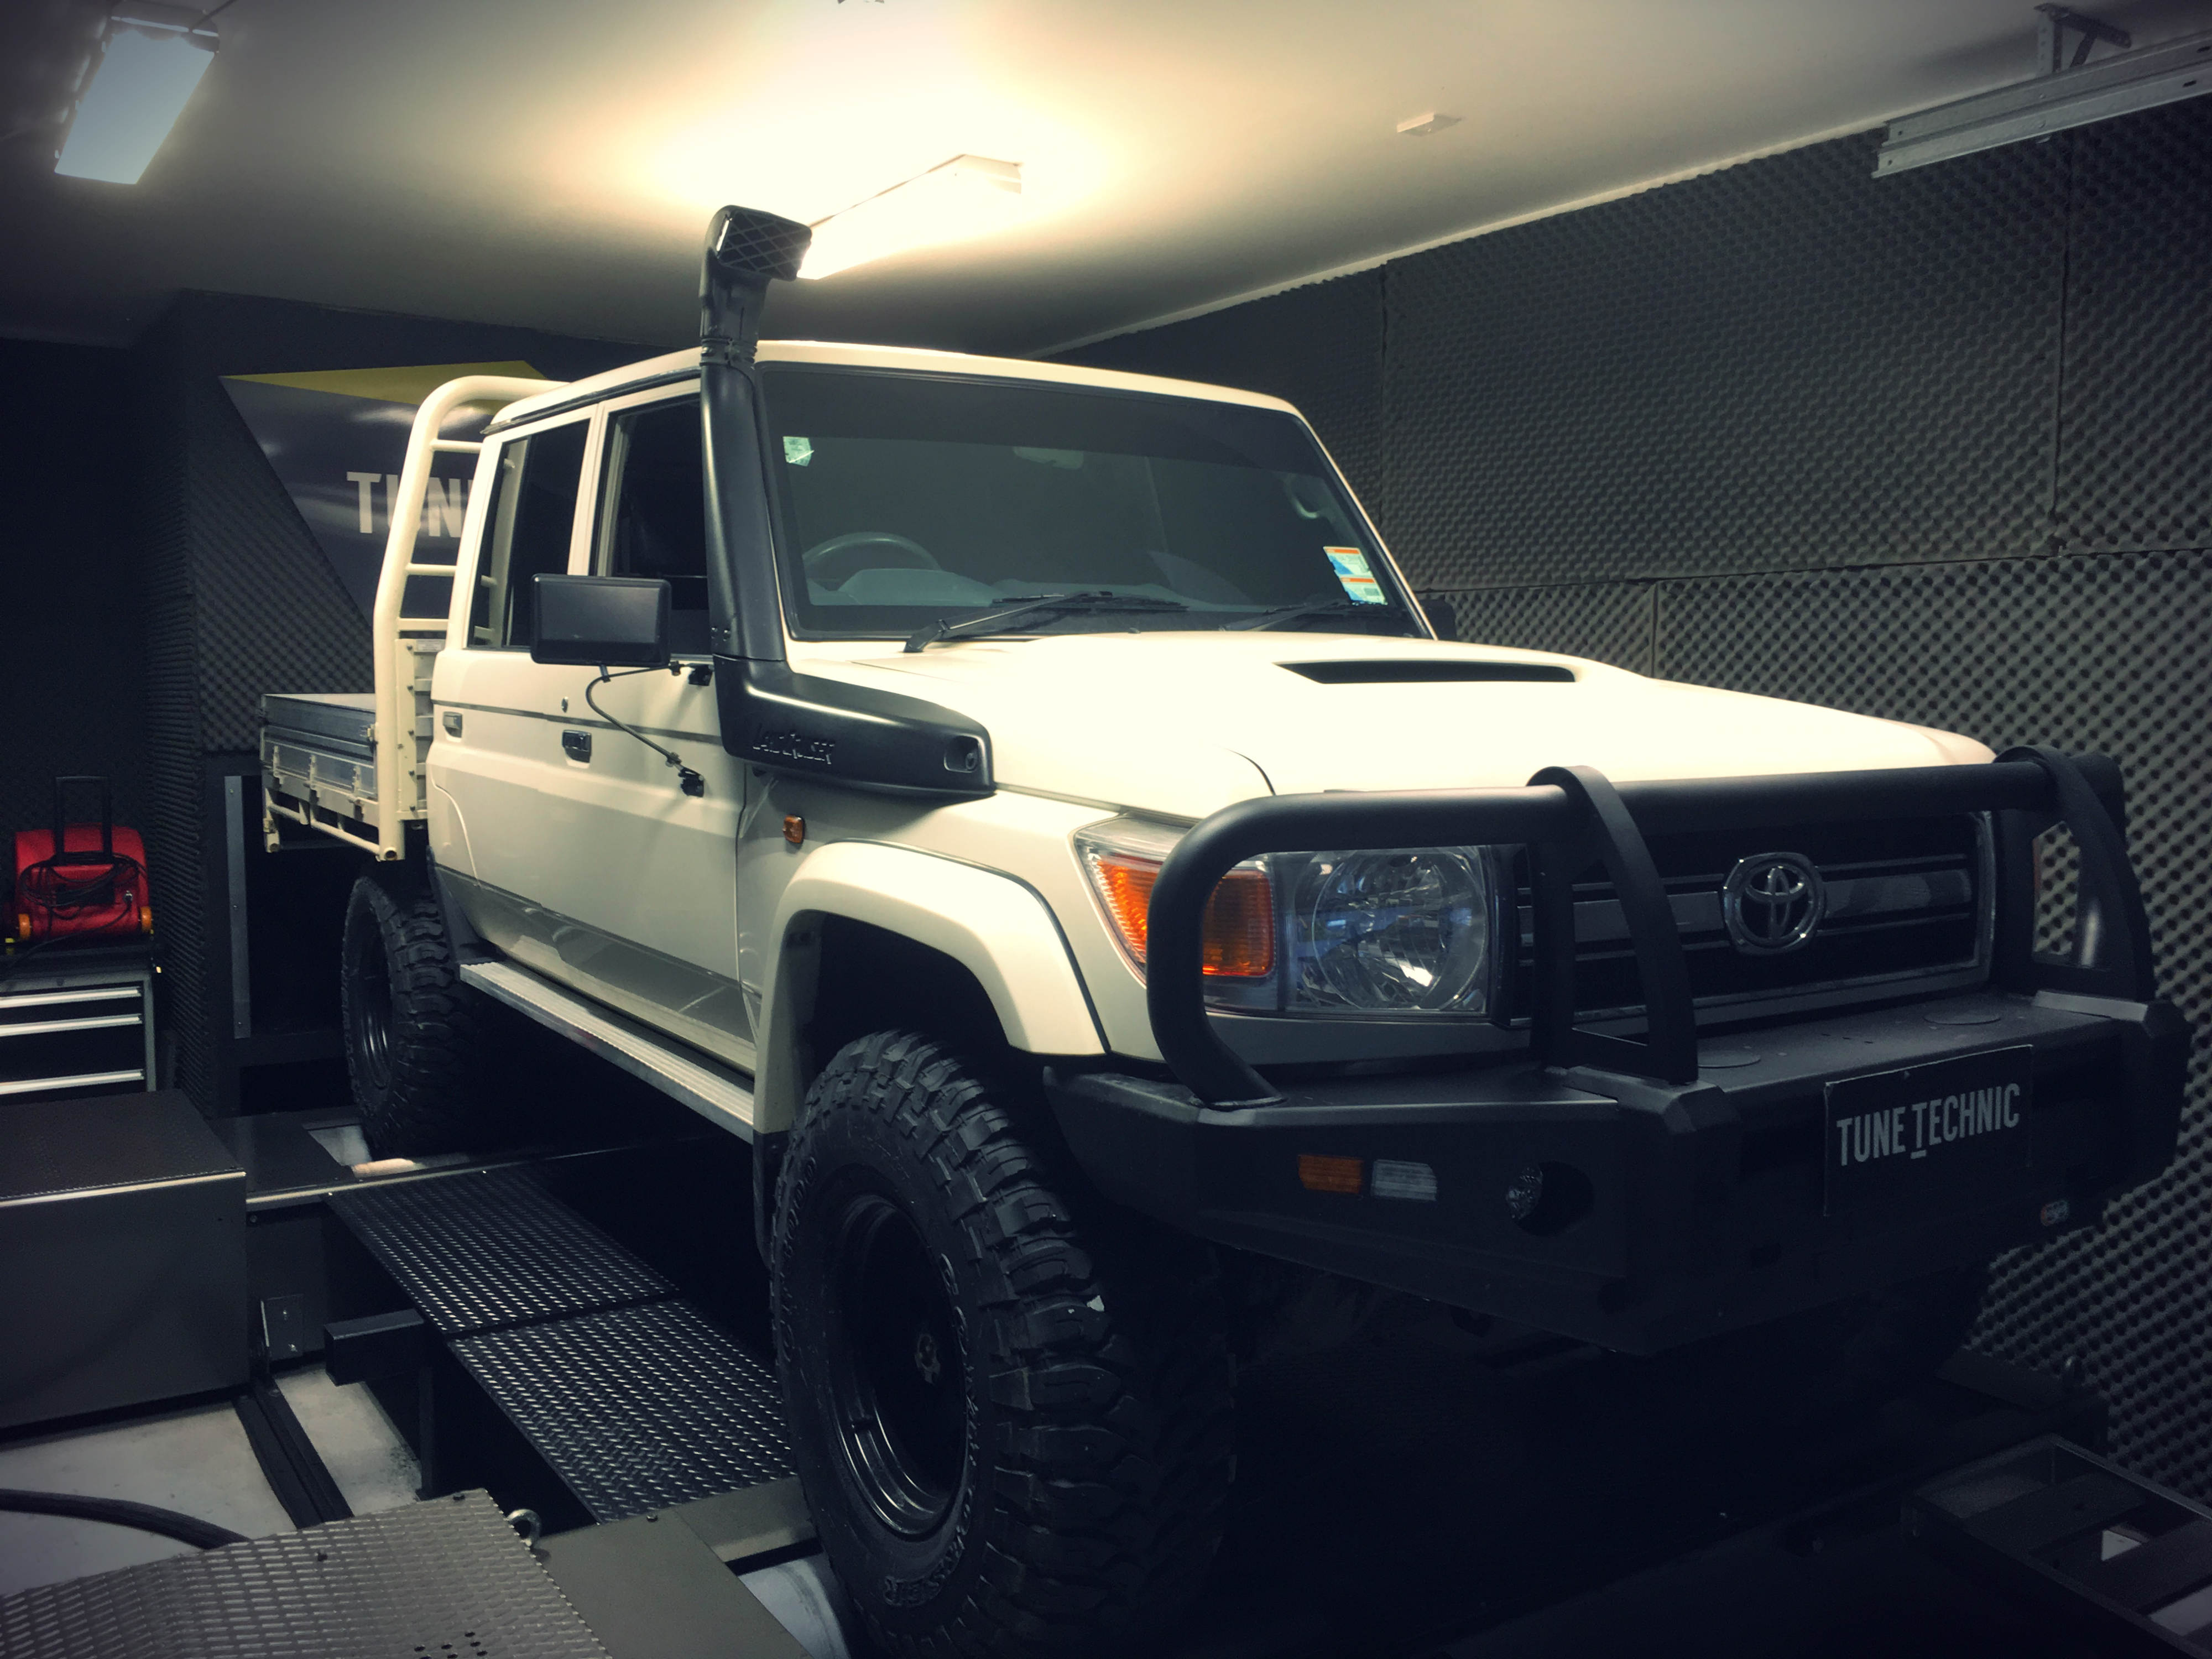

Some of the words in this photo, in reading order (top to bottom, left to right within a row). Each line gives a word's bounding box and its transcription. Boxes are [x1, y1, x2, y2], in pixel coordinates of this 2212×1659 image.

[347, 472, 474, 538] TN
[1837, 1107, 1906, 1166] TUNE
[1911, 1083, 2020, 1160] TECHNIC
